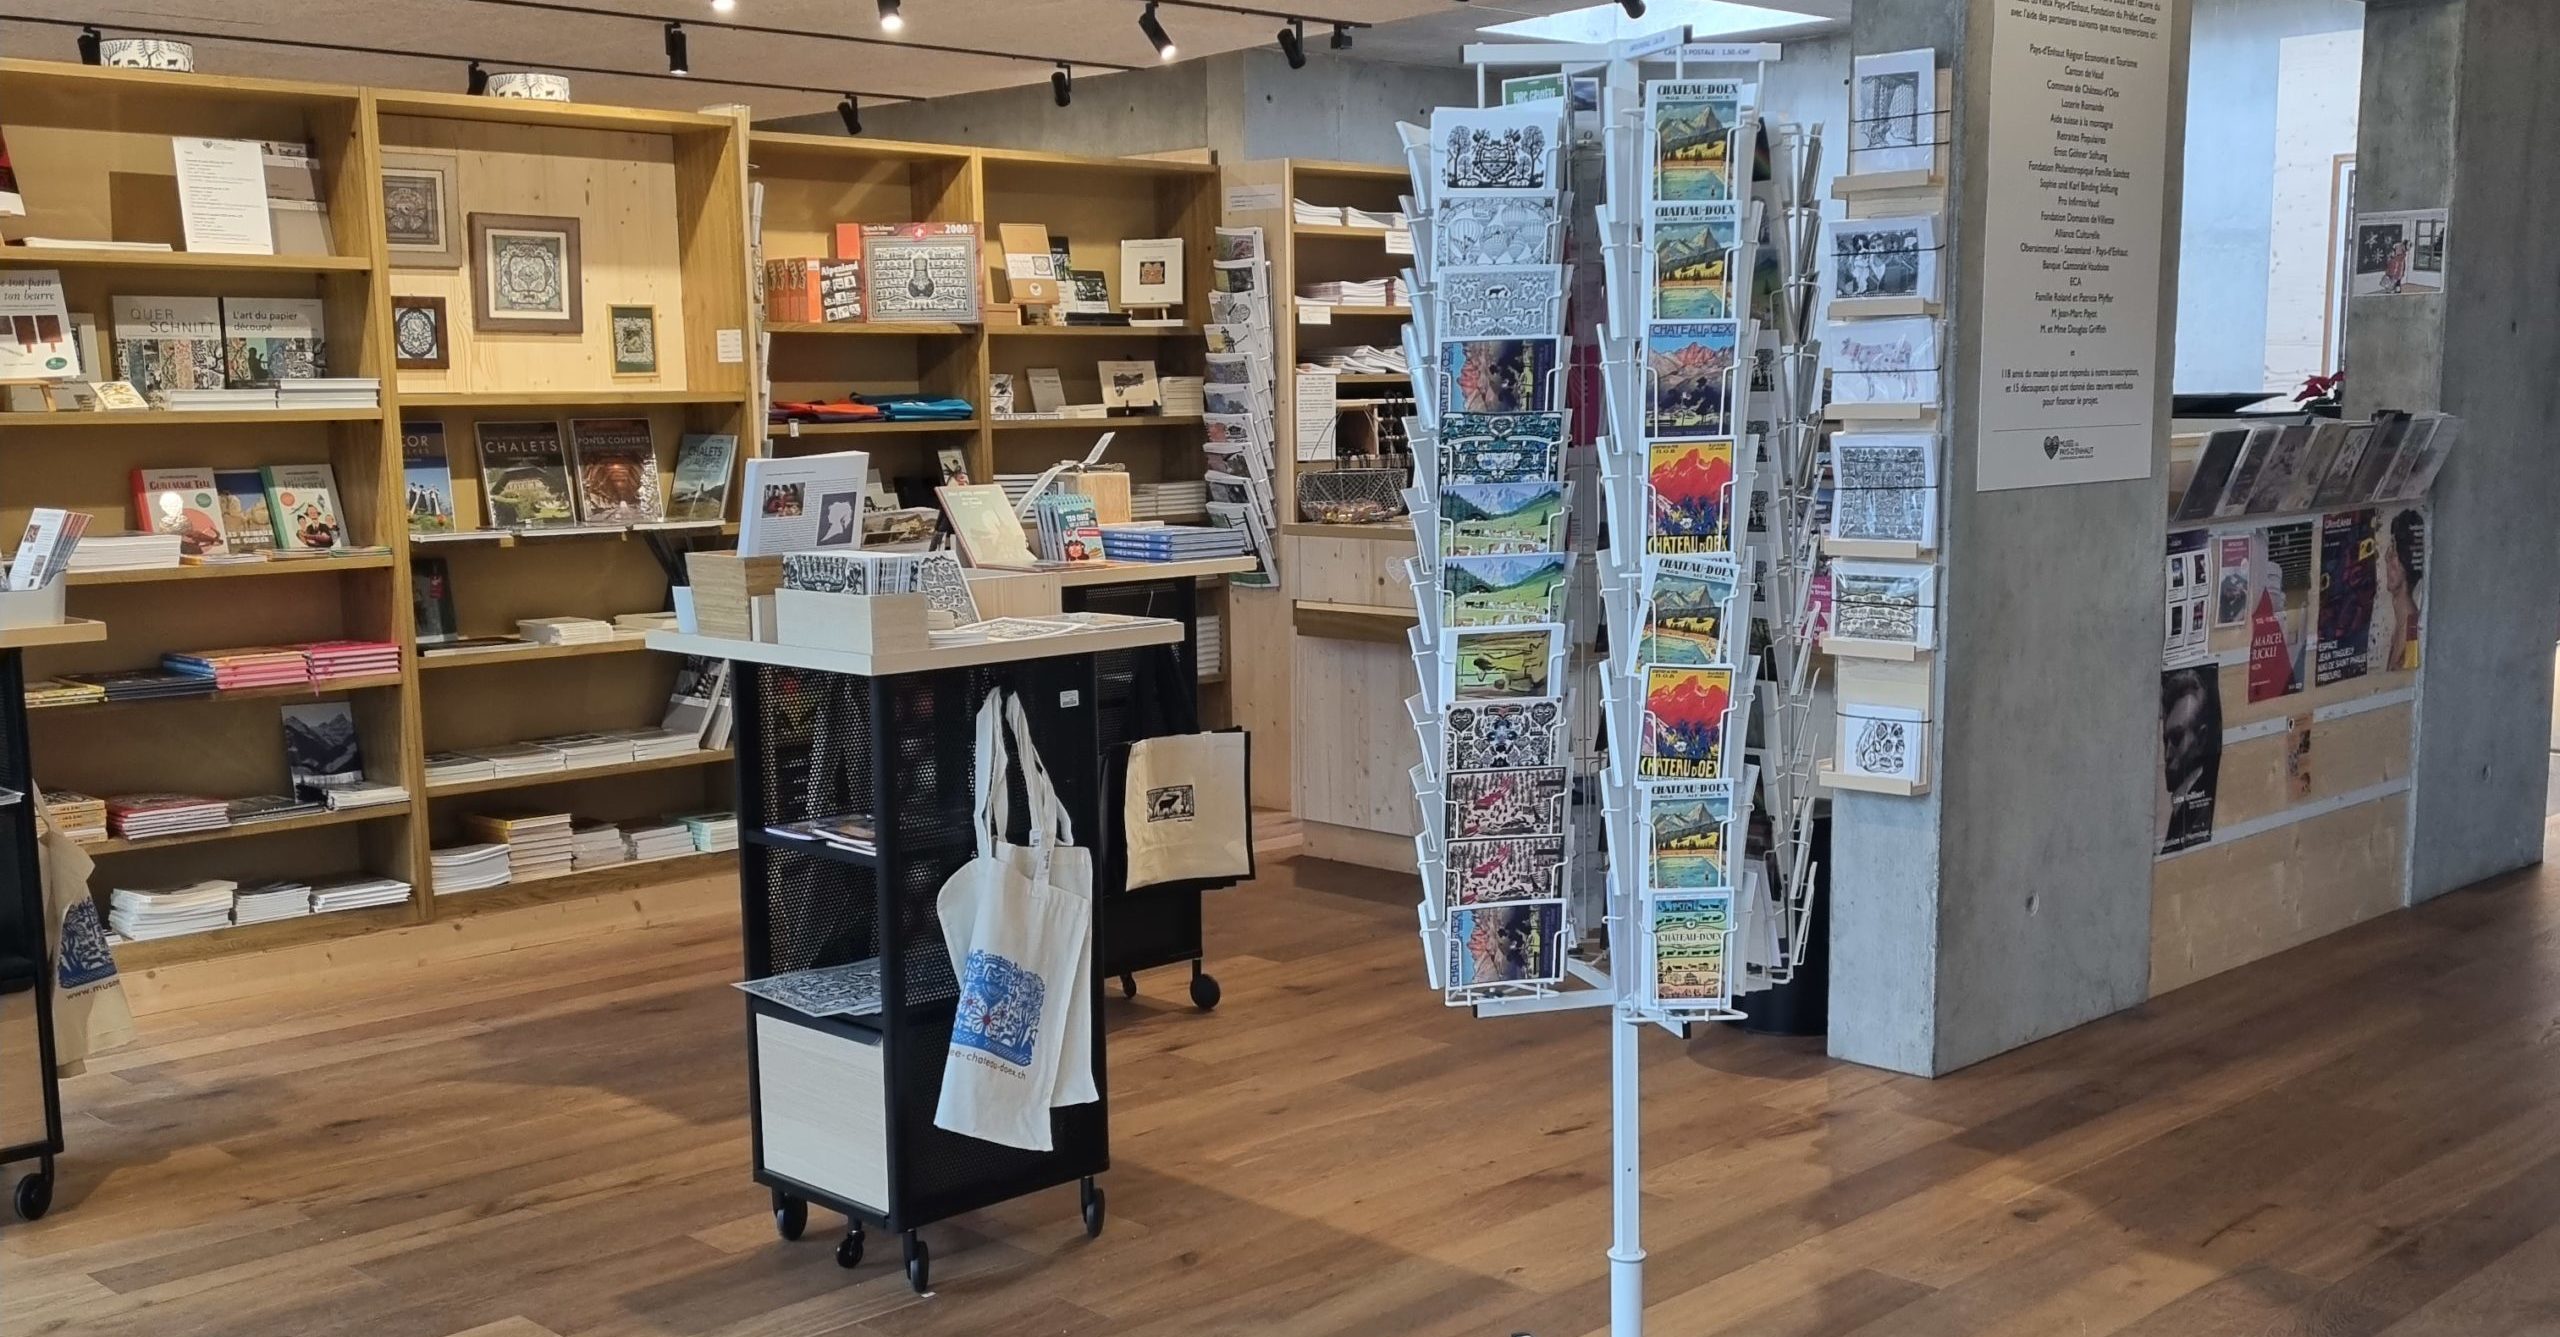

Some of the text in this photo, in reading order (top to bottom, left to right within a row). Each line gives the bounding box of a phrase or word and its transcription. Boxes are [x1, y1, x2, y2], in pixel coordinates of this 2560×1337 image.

[2065, 65, 2083, 76] Canton
[2046, 80, 2073, 92] Commune
[2061, 98, 2080, 109] Loterie
[2029, 161, 2053, 172] Fondation
[2041, 210, 2066, 222] Fondation
[944, 223, 968, 234] 2000
[2055, 229, 2100, 240] Alliance Culturelle
[2069, 277, 2081, 286] ECA
[24, 289, 55, 301] beurre
[130, 308, 175, 320] QUER
[233, 310, 297, 322] L'art du papier
[150, 321, 216, 333] SCHNITT
[234, 321, 273, 333] découpé
[577, 435, 650, 445] PONTS COUVERTS
[485, 440, 558, 453] CHALETS
[687, 445, 723, 457] CHALETS
[1648, 535, 1699, 555] CHATEAU
[1641, 757, 1692, 777] CHATEAU
